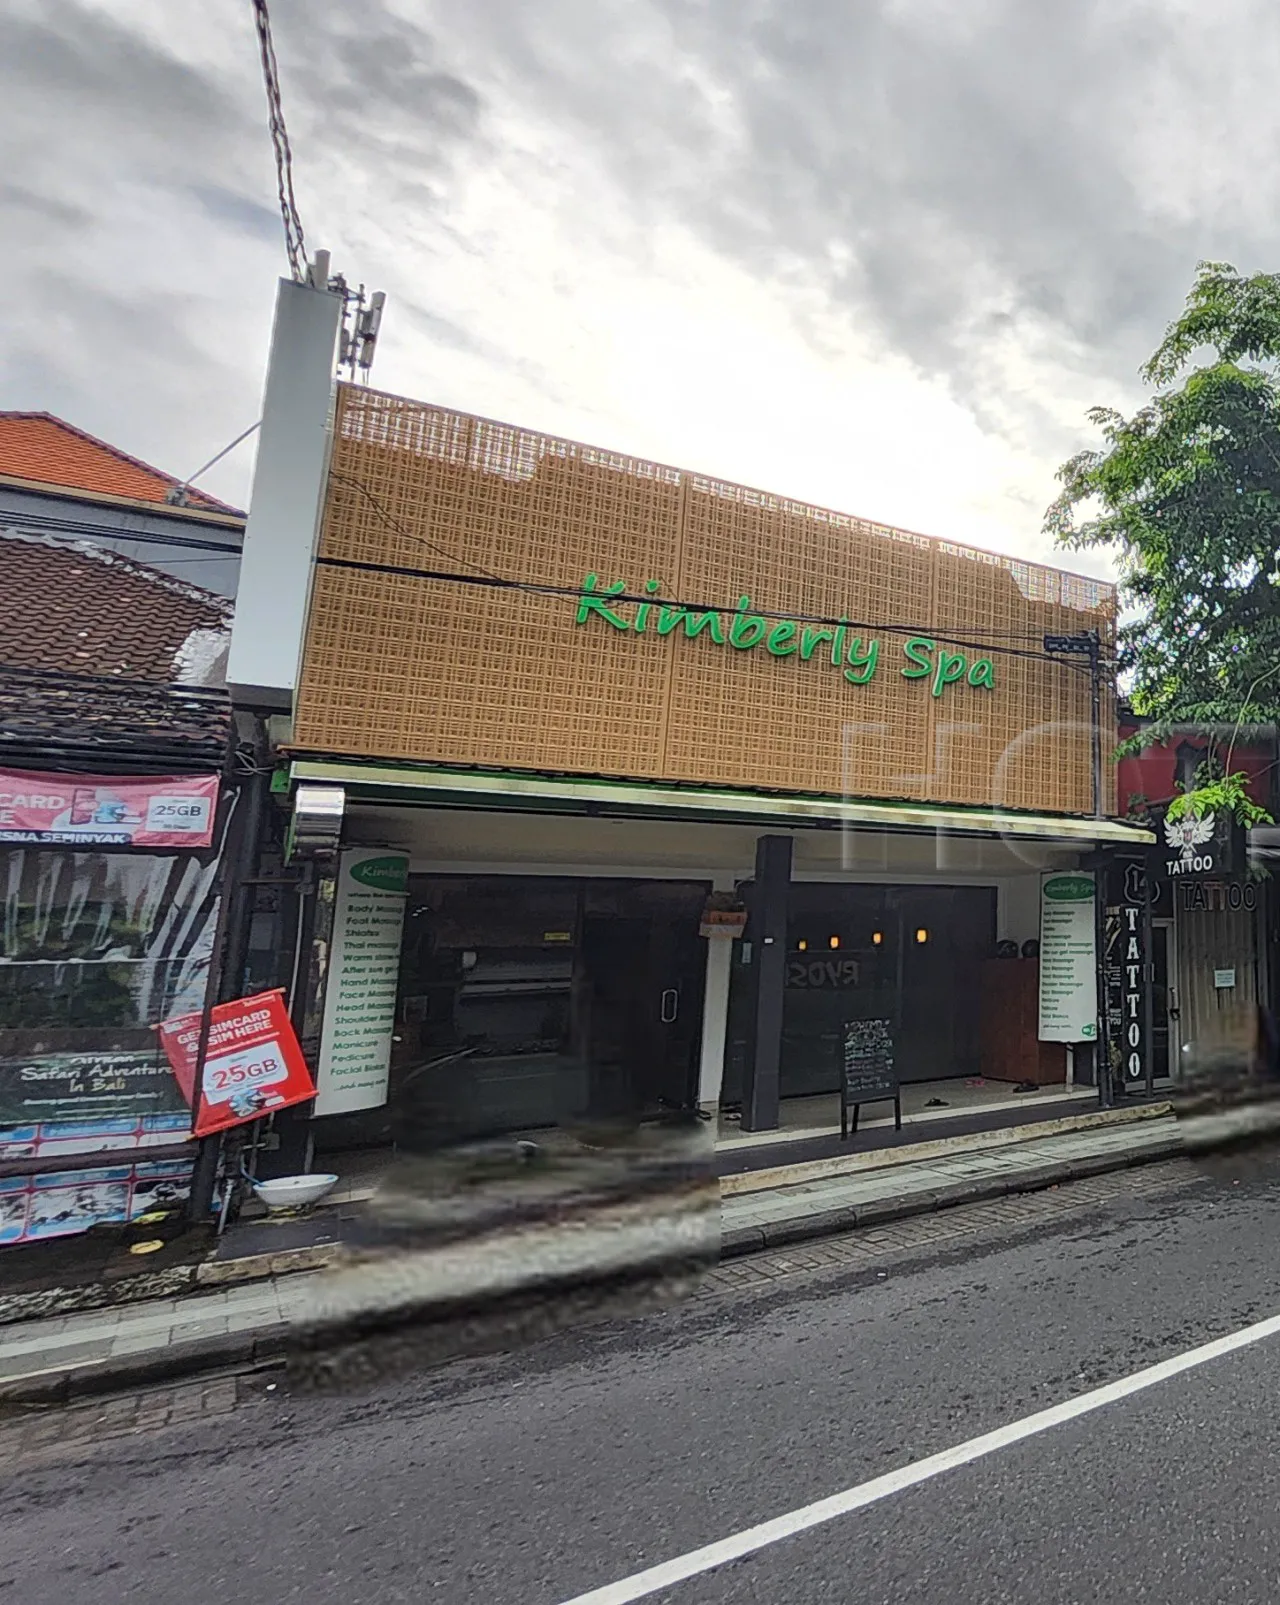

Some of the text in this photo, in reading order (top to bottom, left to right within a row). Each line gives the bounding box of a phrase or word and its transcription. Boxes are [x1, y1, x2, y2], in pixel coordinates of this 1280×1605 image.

[576, 572, 996, 697] Kimberly Spa
[155, 804, 202, 817] 25GB
[0, 830, 125, 844] SNA SEMINYAK
[1166, 855, 1213, 876] TATTOO
[1180, 880, 1257, 912] TATTOO
[348, 905, 373, 913] Body
[346, 917, 369, 925] Foot
[341, 978, 369, 987] Hand
[340, 991, 365, 999] Face
[1125, 907, 1141, 1078] TATTOO
[336, 1003, 365, 1012] Head
[209, 1009, 271, 1035] SIMCARD
[236, 1019, 273, 1041] HERE
[334, 1027, 361, 1037] Back
[332, 1040, 379, 1050] Manicure
[331, 1053, 376, 1063] Pedicure
[20, 1064, 175, 1081] Safari Adventure
[212, 1058, 278, 1090] 25GB
[330, 1065, 362, 1076] Facial
[91, 1077, 126, 1092] Bali
